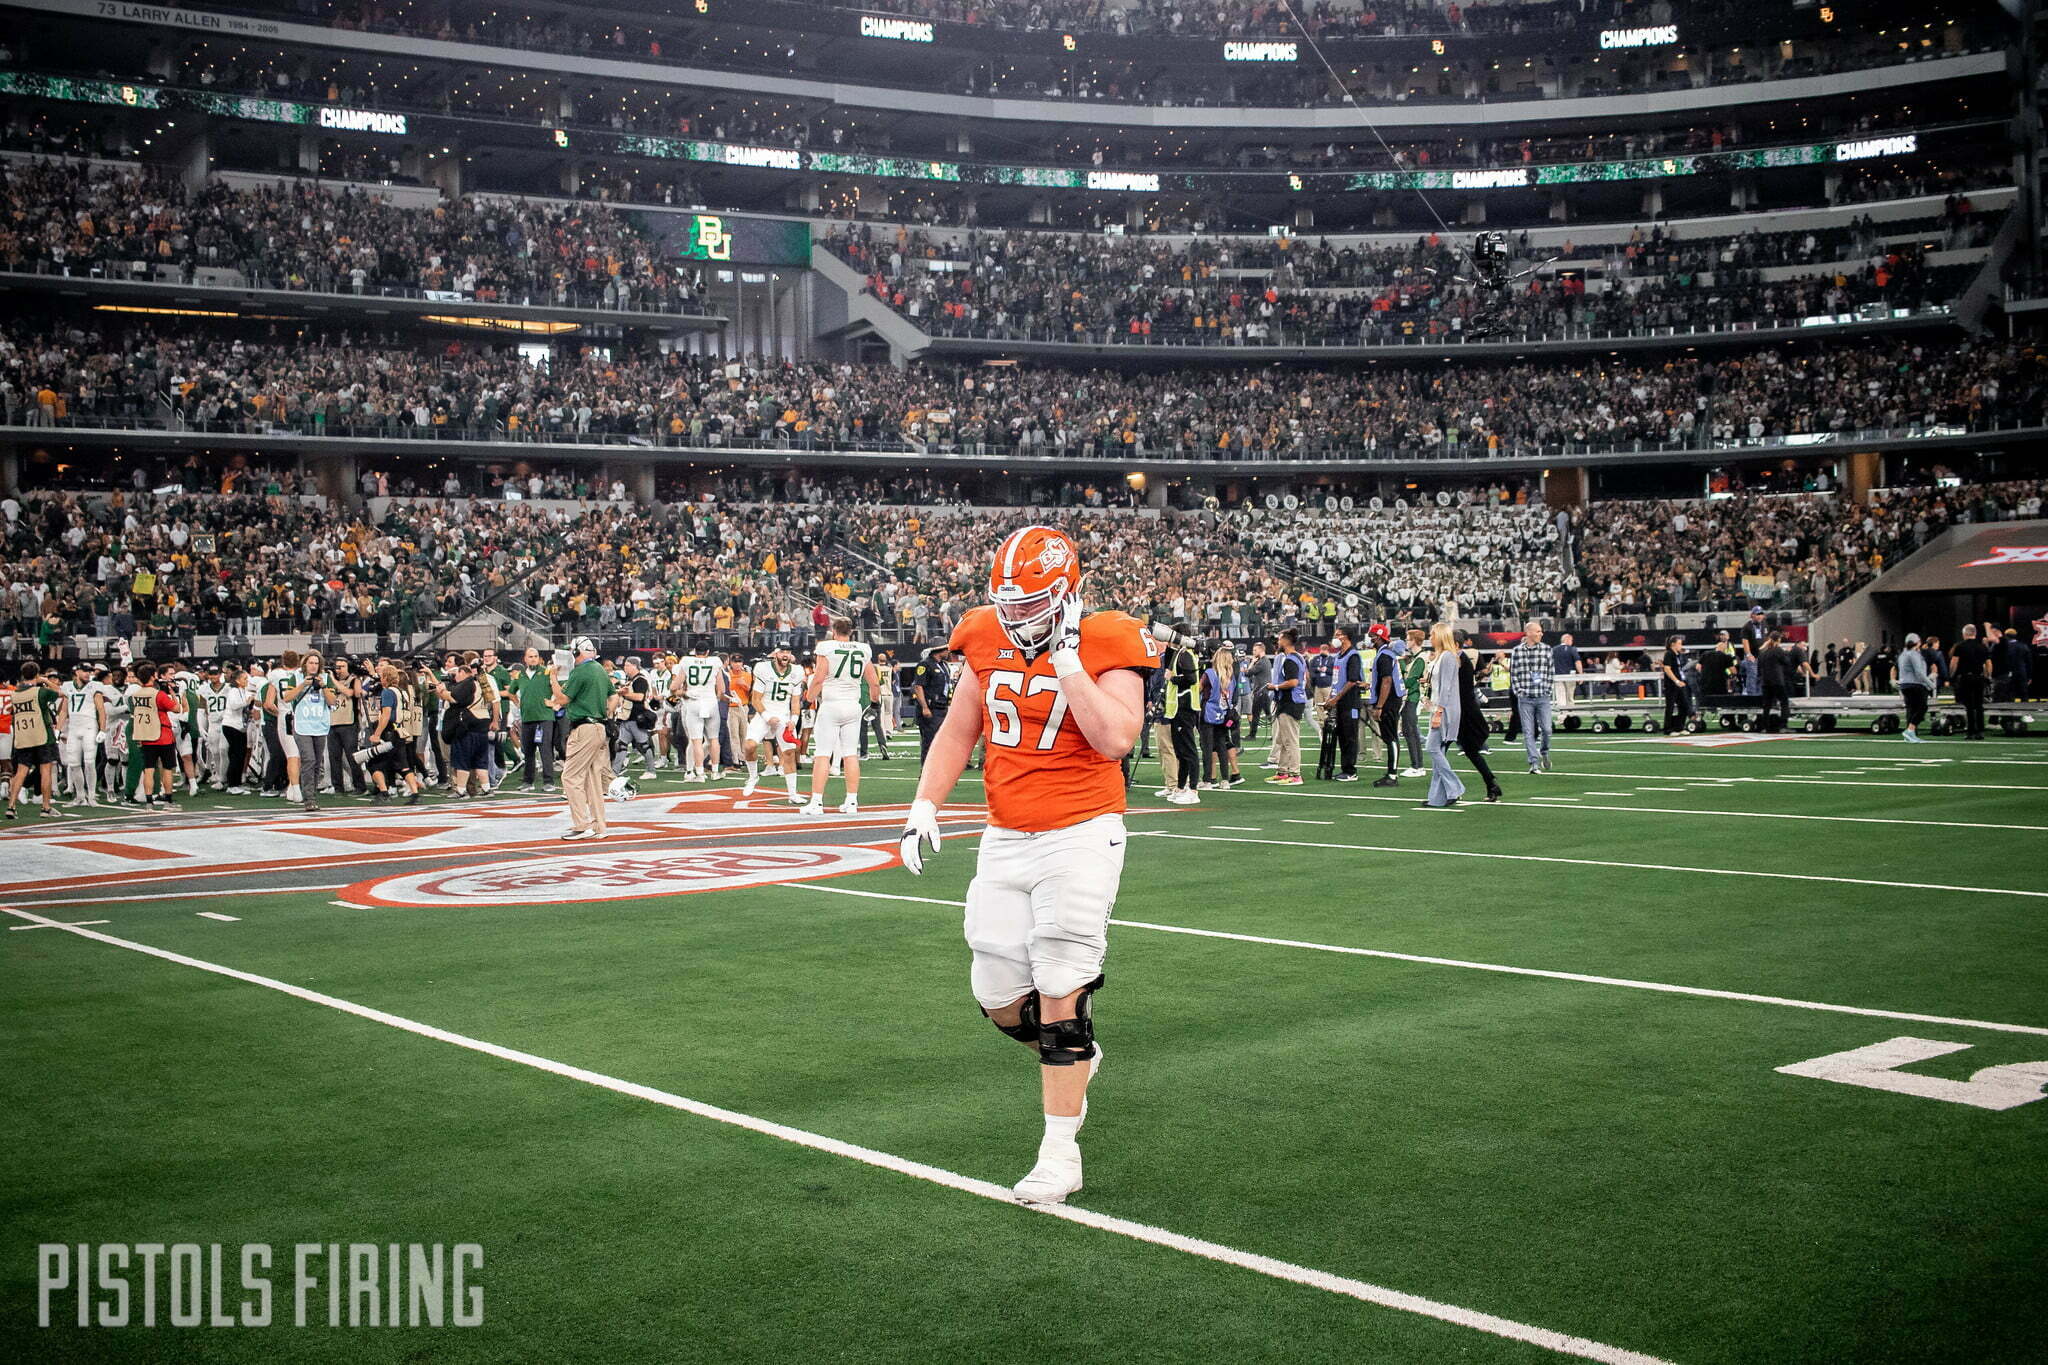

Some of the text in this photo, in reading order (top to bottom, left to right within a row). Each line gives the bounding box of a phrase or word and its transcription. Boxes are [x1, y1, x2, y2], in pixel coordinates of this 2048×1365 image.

[97, 2, 116, 15] 73
[122, 5, 171, 22] LARRY
[174, 12, 220, 28] ALLEN
[860, 16, 934, 42] CHAMPIONS
[1601, 24, 1678, 49] CHAMPIONS
[1224, 41, 1298, 61] CHAMPIONS
[320, 107, 406, 134] CHAMPIONS
[725, 145, 801, 170] CHAMPIONS
[1837, 135, 1916, 161] CHAMPIONS
[1087, 171, 1160, 192] CHAMPIONS
[1453, 168, 1528, 189] CHAMPIONS
[698, 215, 732, 261] BU
[688, 665, 713, 686] 87
[834, 649, 865, 679] 76
[71, 693, 86, 713] 17
[771, 681, 790, 701] 15
[207, 695, 227, 713] 20
[985, 669, 1069, 751] 67
[15, 718, 35, 731] 131
